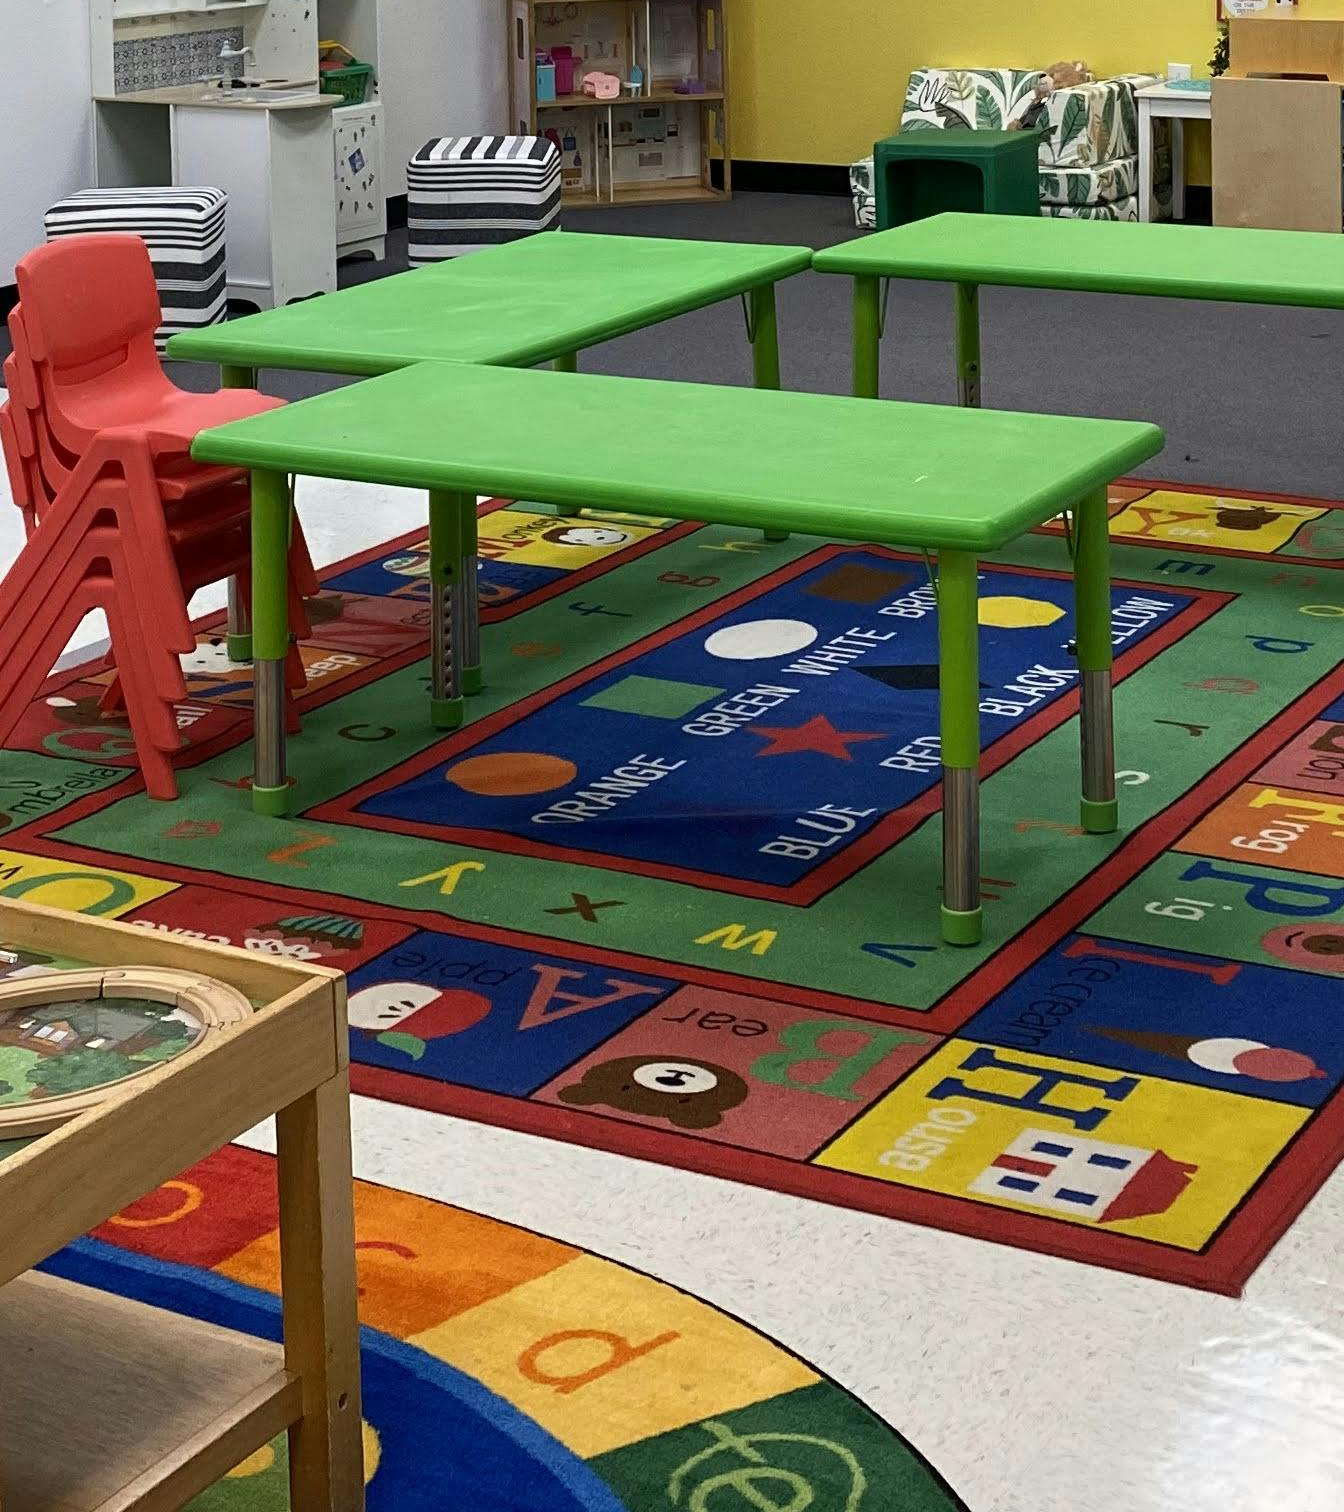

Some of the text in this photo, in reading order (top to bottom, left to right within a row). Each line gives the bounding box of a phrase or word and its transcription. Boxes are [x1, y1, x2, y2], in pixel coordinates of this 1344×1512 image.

[781, 626, 898, 676] WHITE
[681, 683, 801, 737] GREEN
[978, 665, 1080, 717] BLACK
[879, 736, 942, 773] RED
[531, 753, 687, 824] ORANGE
[758, 803, 878, 861] BLUE
[398, 861, 486, 895] y
[542, 892, 625, 923] x
[693, 923, 778, 956] w
